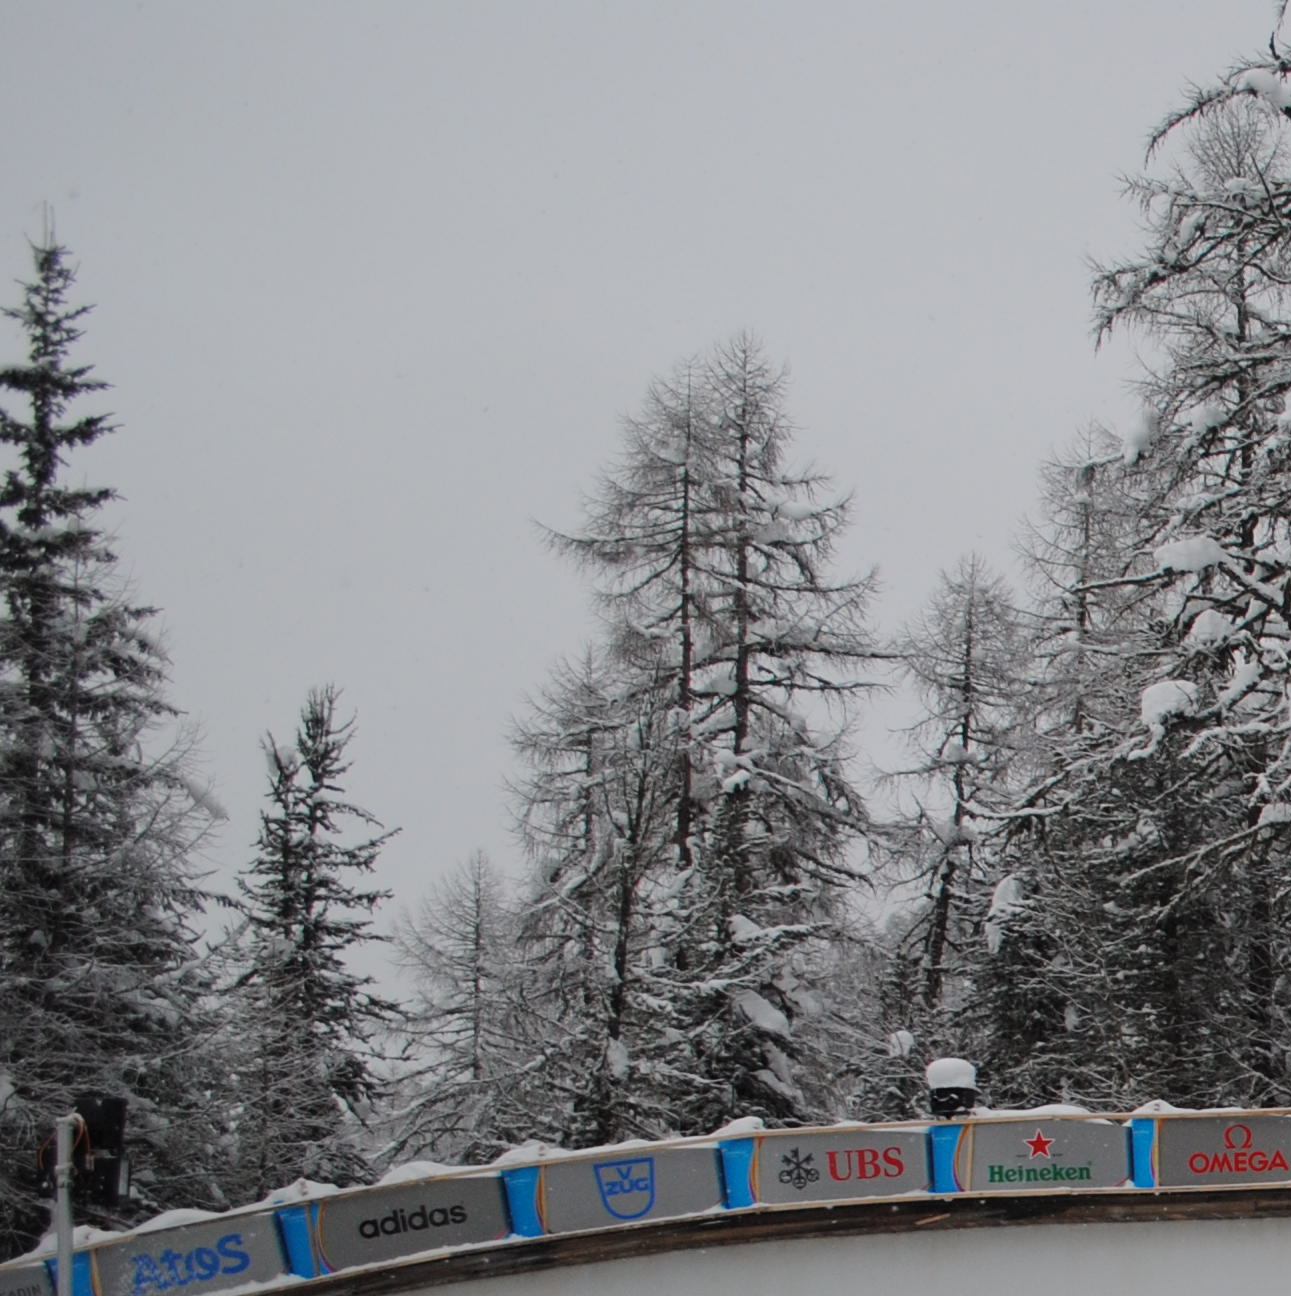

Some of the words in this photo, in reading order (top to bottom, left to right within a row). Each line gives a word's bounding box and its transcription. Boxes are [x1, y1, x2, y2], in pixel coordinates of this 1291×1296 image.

[827, 1147, 905, 1181] UBS
[1188, 1150, 1289, 1173] OMEGA
[616, 1166, 632, 1180] V
[988, 1163, 1092, 1183] Heineken
[606, 1177, 649, 1197] ZUG
[359, 1202, 468, 1240] adidas
